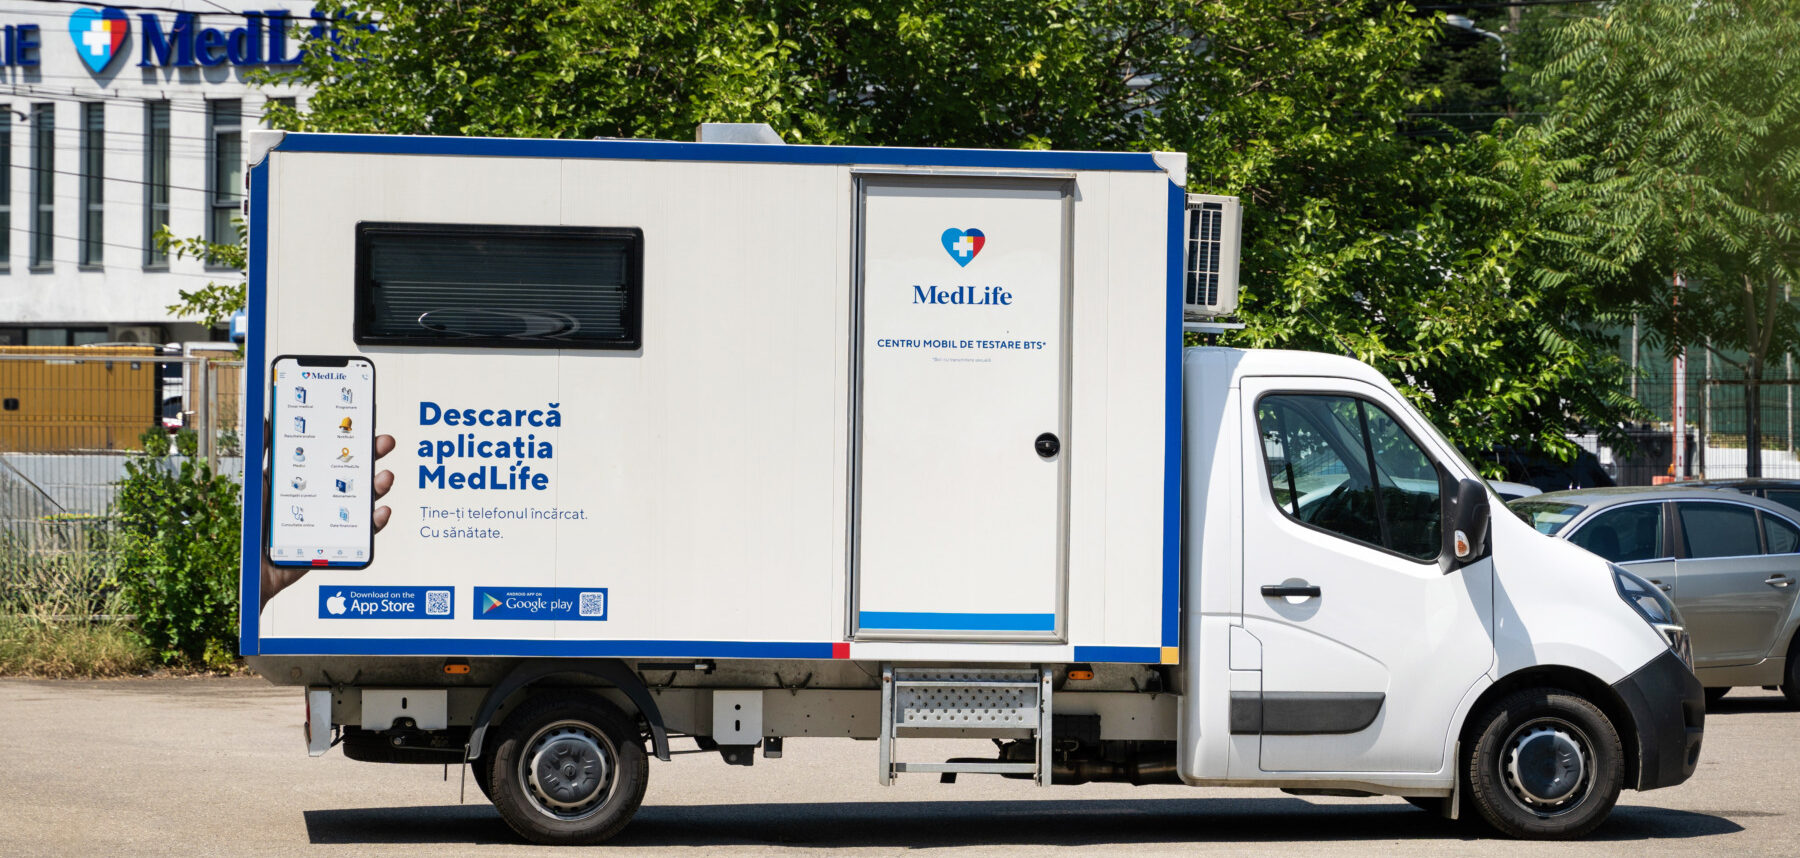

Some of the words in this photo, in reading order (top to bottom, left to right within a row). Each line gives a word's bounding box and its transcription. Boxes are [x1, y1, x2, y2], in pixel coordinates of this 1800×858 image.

[0, 24, 41, 65] IE
[912, 285, 1013, 305] MedLife
[877, 339, 921, 348] CENTRU
[923, 339, 957, 348] MOBIL
[960, 340, 974, 349] DE
[977, 340, 1021, 349] TESTARE
[312, 372, 347, 380] MedLife
[419, 401, 562, 427] Descarcă
[417, 433, 553, 466] aplicația
[418, 465, 549, 491] MedLife
[420, 506, 464, 522] Ține-ți
[468, 507, 528, 520] telefonul
[531, 507, 588, 520] încărcat.
[420, 526, 440, 538] Cu
[443, 526, 504, 539] sănătate.
[350, 599, 379, 615] App
[381, 599, 415, 612] Store
[505, 597, 547, 613] Google
[550, 598, 573, 612] play
